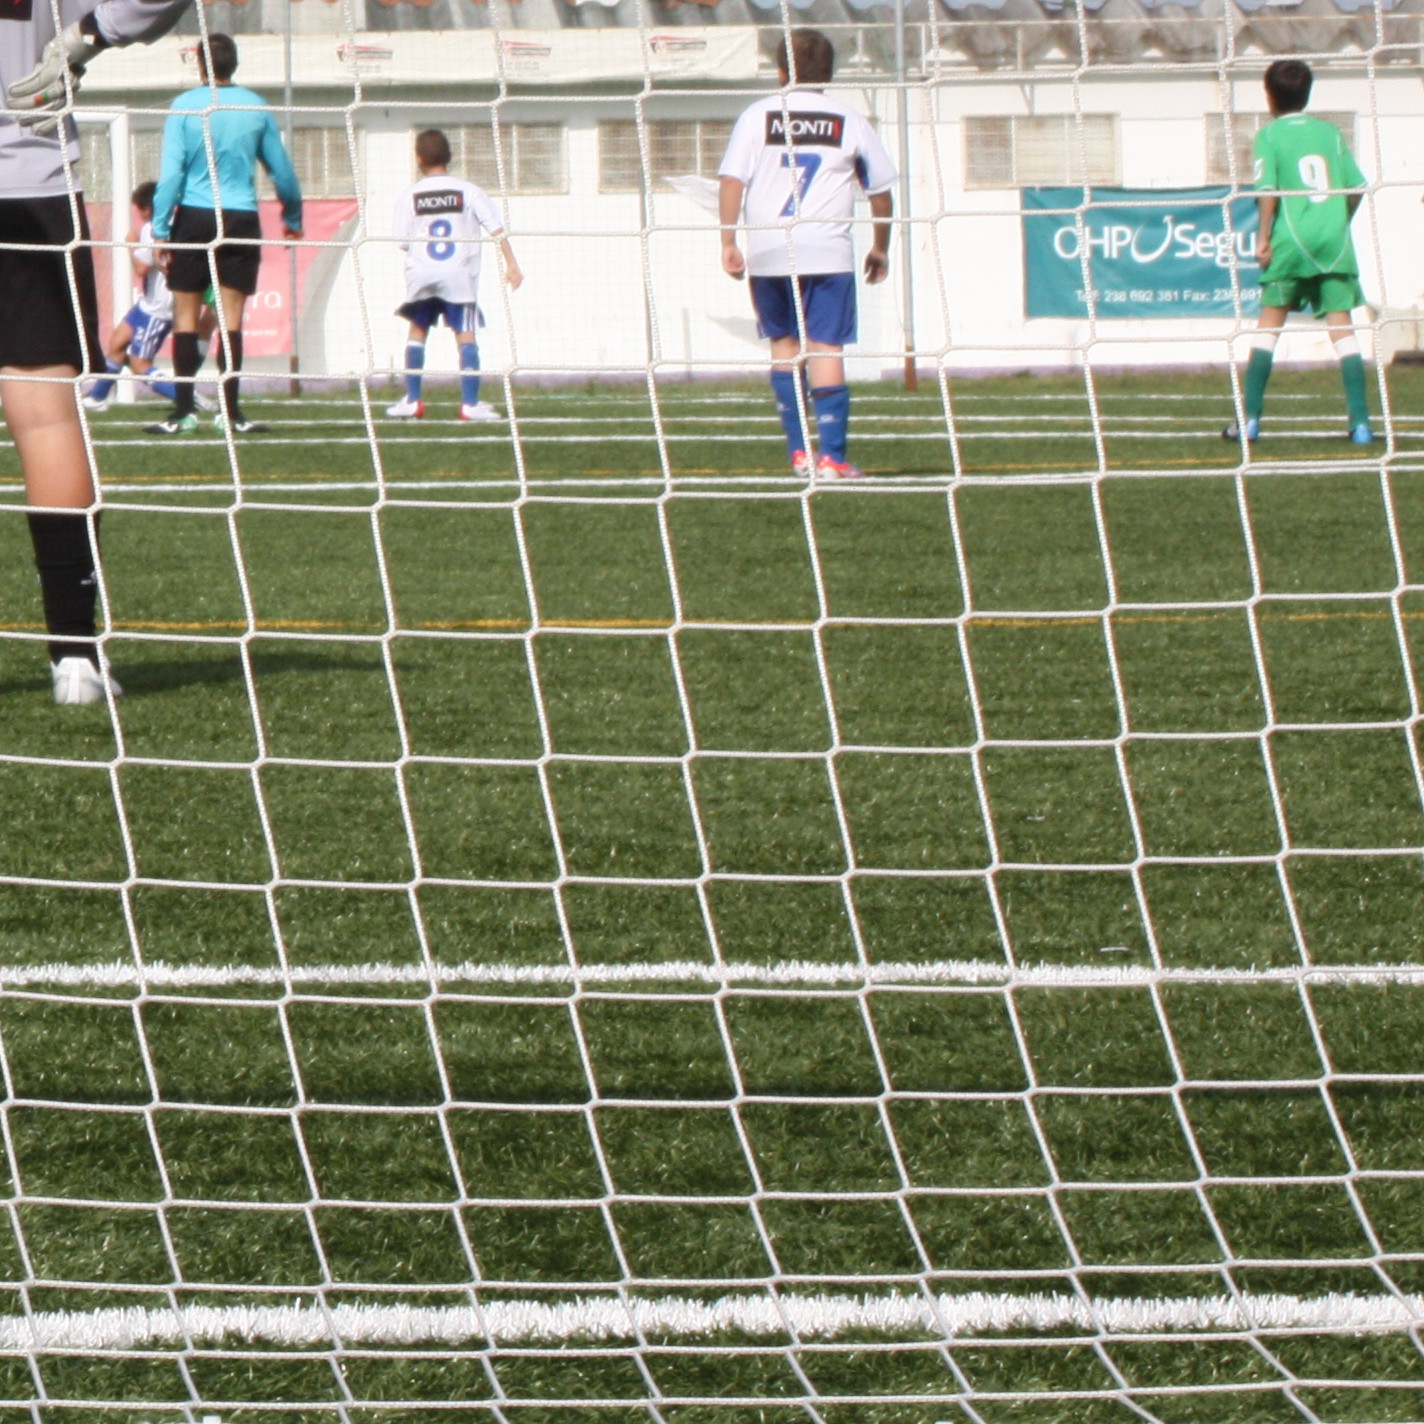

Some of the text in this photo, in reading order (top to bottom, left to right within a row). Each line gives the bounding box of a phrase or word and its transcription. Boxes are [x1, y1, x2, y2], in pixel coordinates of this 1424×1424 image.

[779, 153, 822, 217] 7
[1298, 154, 1329, 204] 9
[427, 219, 456, 261] 8
